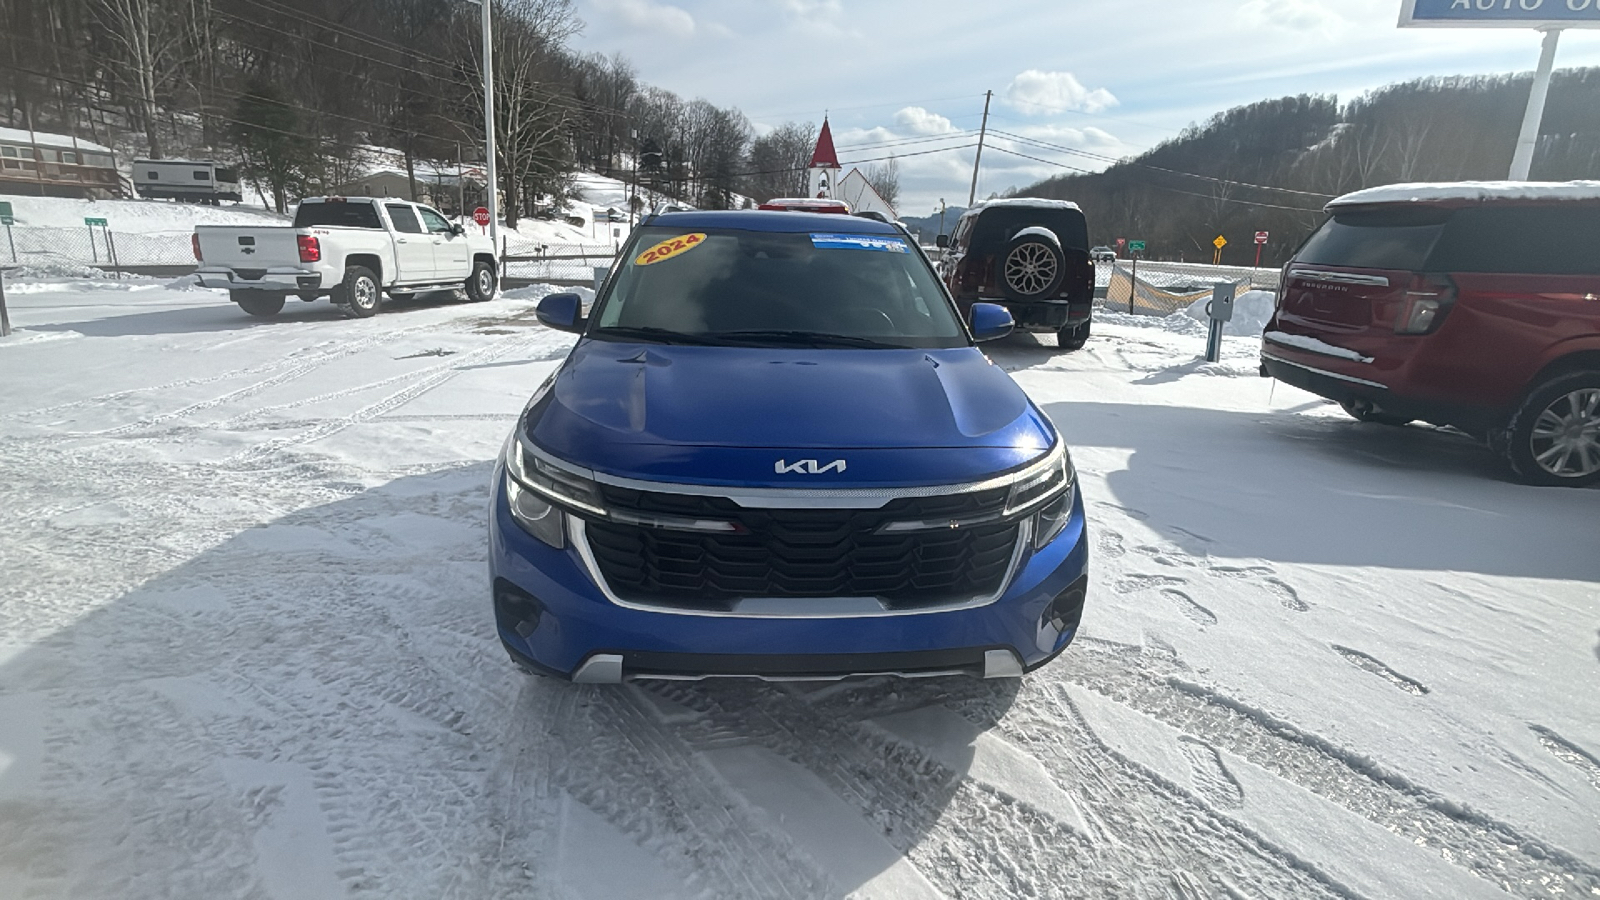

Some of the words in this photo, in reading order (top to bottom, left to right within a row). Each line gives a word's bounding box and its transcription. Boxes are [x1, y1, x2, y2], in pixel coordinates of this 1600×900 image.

[1566, 0, 1600, 11] O
[642, 234, 701, 264] 2024
[774, 459, 847, 474] KIA
